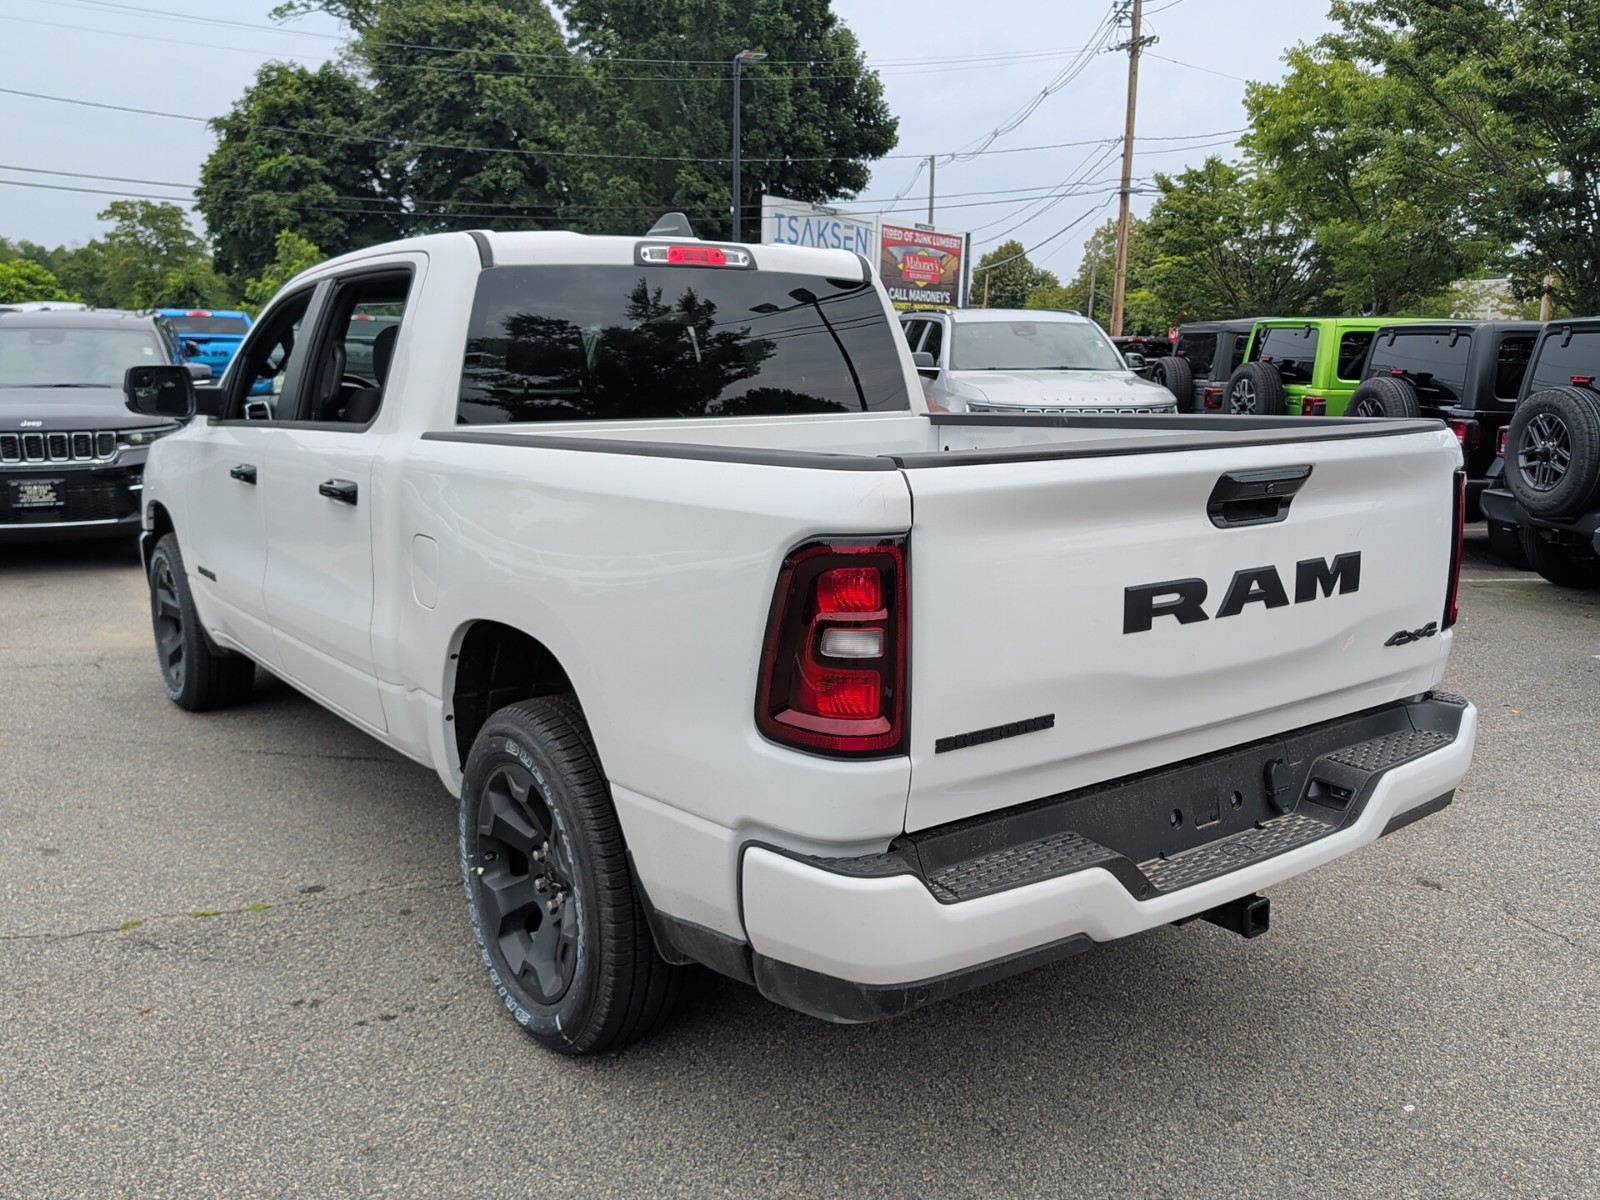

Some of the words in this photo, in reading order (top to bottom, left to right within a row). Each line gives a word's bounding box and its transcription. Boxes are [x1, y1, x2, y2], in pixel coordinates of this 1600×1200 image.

[773, 212, 868, 255] ISAKSEN
[882, 228, 903, 240] TIRED
[904, 231, 914, 242] OF
[914, 232, 932, 245] JUNK
[932, 236, 961, 249] LUMBER?
[889, 287, 908, 301] CALL
[909, 289, 951, 303] MAHONEY'S
[20, 420, 42, 428] Jeep
[1123, 551, 1361, 634] RAM
[1384, 621, 1438, 648] 4x4
